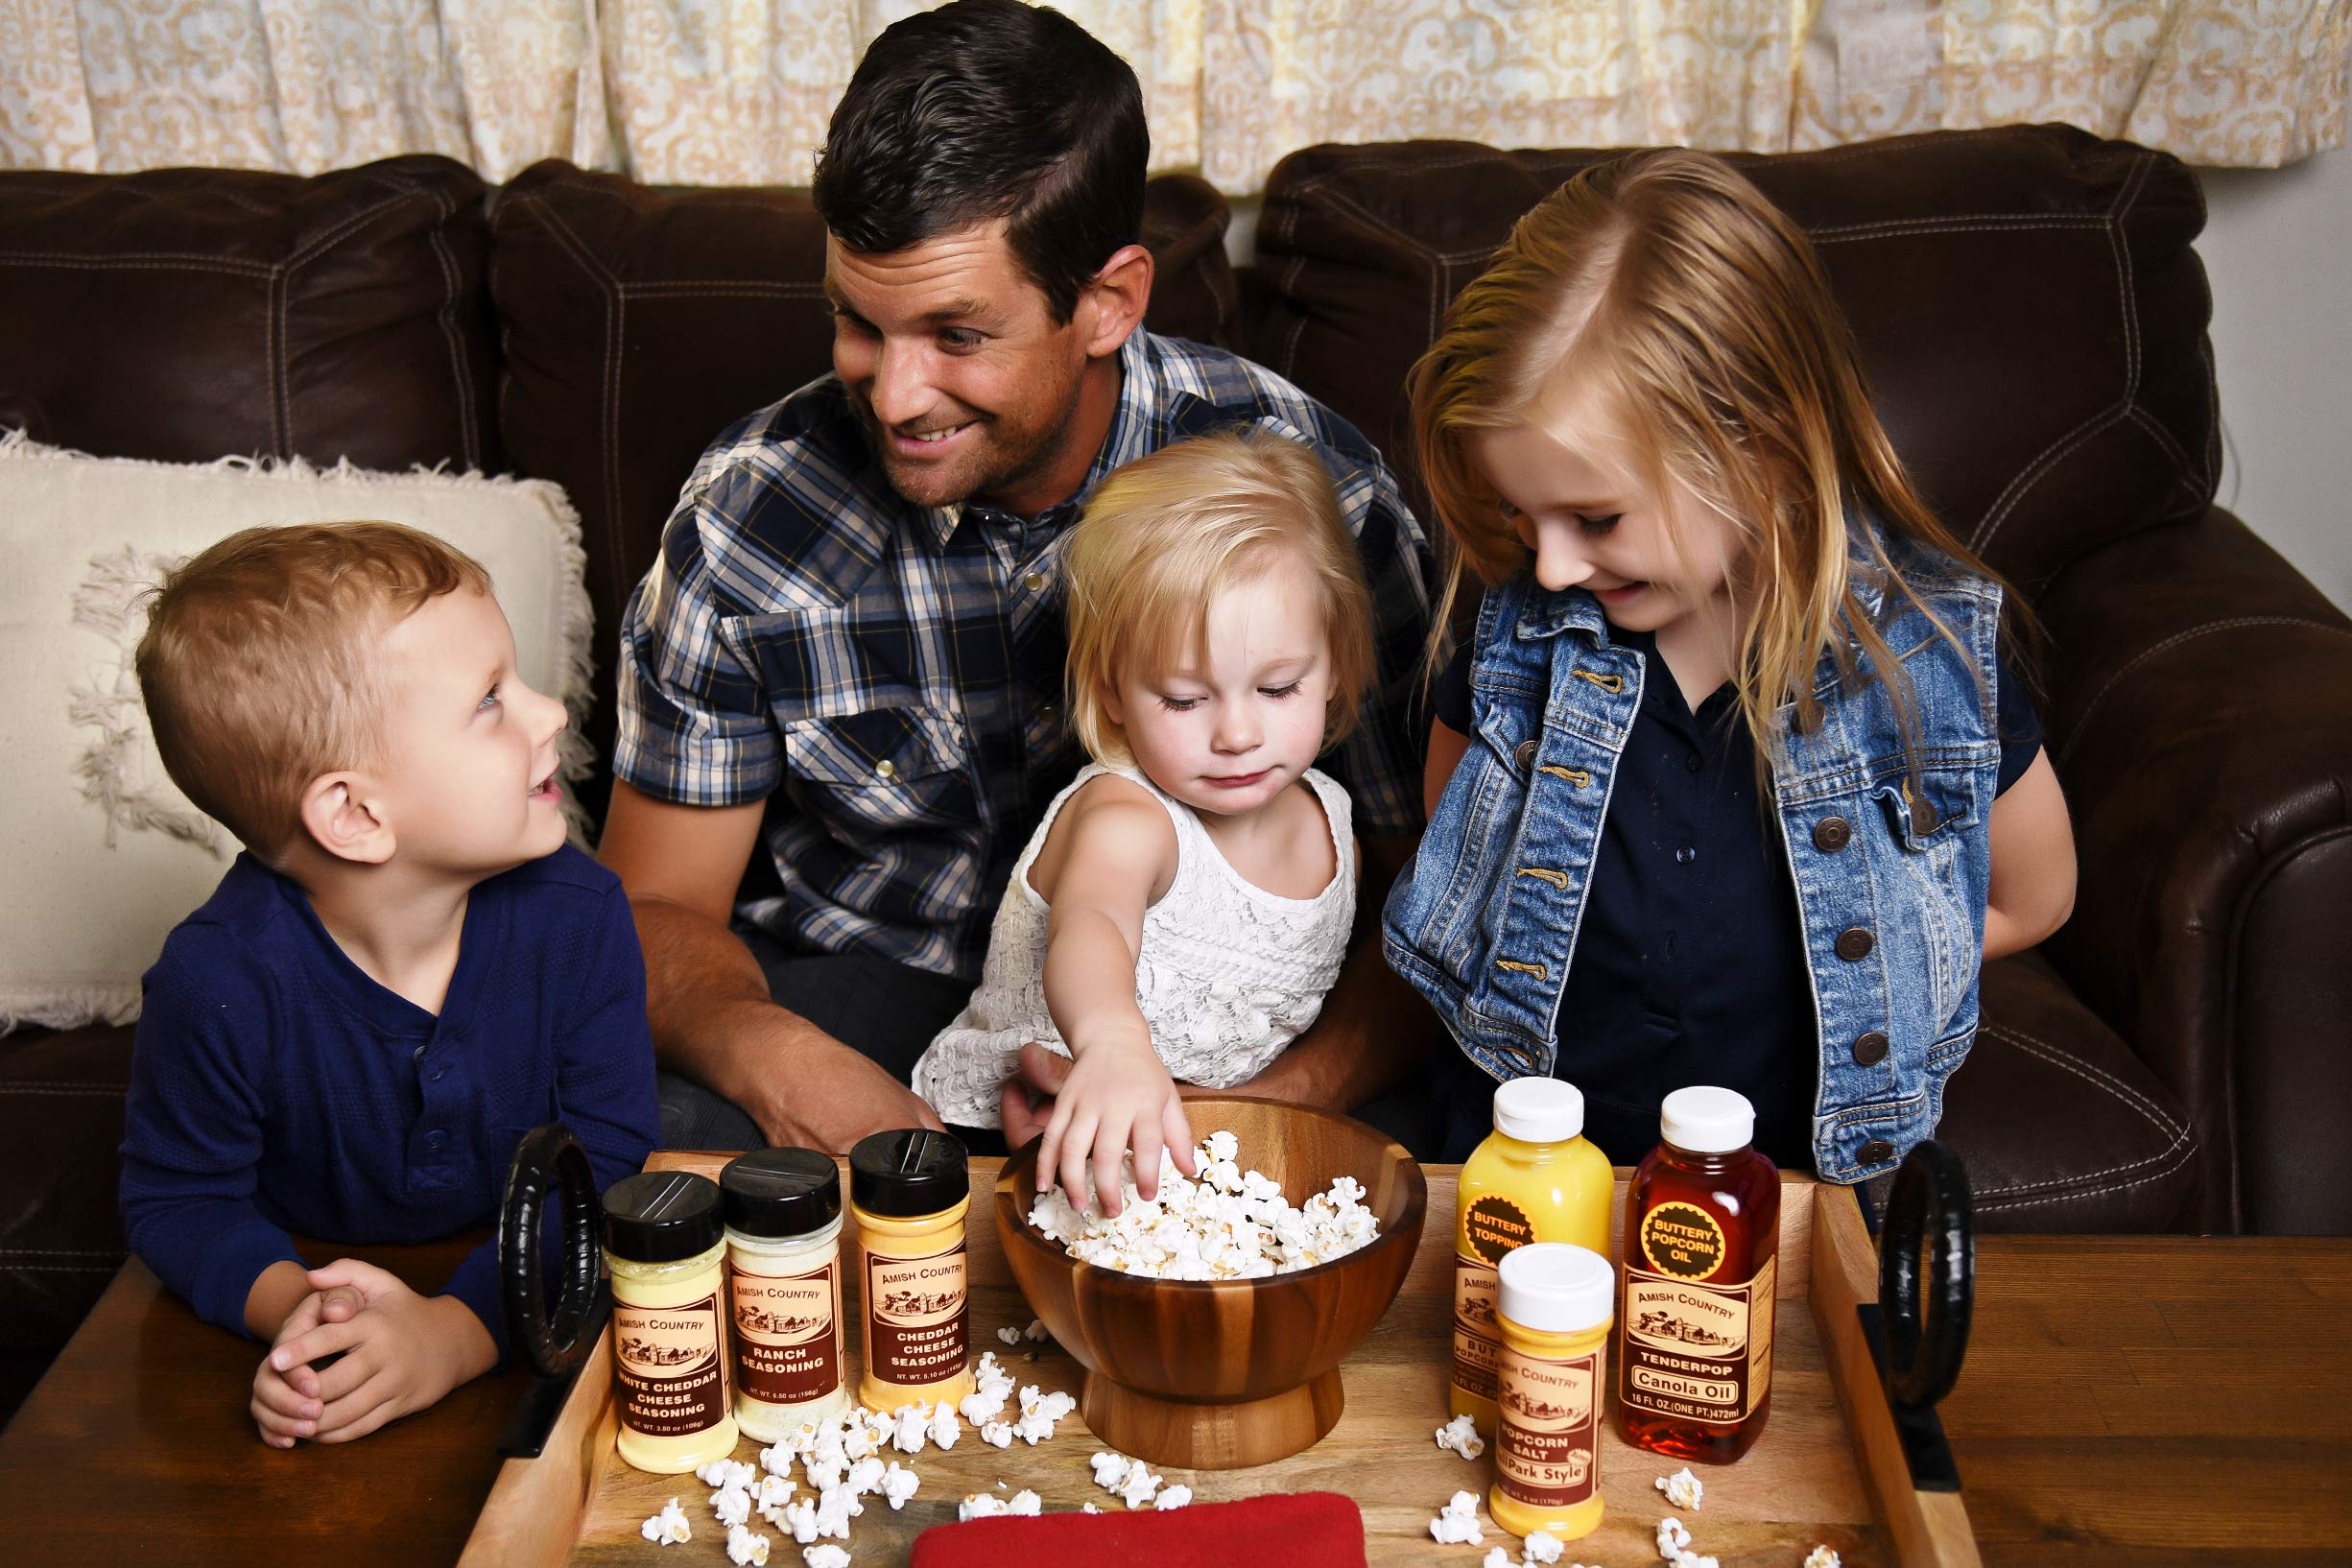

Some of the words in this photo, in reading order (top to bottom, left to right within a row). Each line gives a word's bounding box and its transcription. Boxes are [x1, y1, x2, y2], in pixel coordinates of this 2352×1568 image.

[1474, 1211, 1526, 1235] BUTTERY
[1654, 1220, 1713, 1241] BUTTERY
[1651, 1232, 1714, 1254] POPCORN
[1671, 1249, 1692, 1263] OIL
[883, 1272, 916, 1284] AMISH
[920, 1264, 962, 1278] COUNTRY
[1464, 1277, 1496, 1290] AMISH
[737, 1286, 763, 1296] AMISH
[768, 1288, 820, 1299] COUNTRY
[1639, 1293, 1674, 1303] AMISH
[1678, 1294, 1735, 1319] COUNTRY
[650, 1319, 704, 1330] COUNTRY
[897, 1322, 959, 1342] CHEDDAR
[754, 1347, 806, 1360] RANCH
[891, 1344, 962, 1366] SEASONING
[904, 1337, 955, 1354] CHEESE
[742, 1355, 823, 1373] SEASONING
[1641, 1352, 1733, 1376] TENDERPOP
[619, 1370, 649, 1390] WHITE
[653, 1370, 717, 1392] CHEDDAR
[1521, 1367, 1579, 1390] COUNTRY
[1639, 1372, 1698, 1395] Canola
[1705, 1385, 1729, 1399] Oil
[637, 1394, 691, 1405] CHEESE
[1632, 1393, 1642, 1403] 16
[629, 1403, 705, 1417] SEASONING
[1513, 1443, 1548, 1460] SALT
[1544, 1466, 1581, 1485] Style
